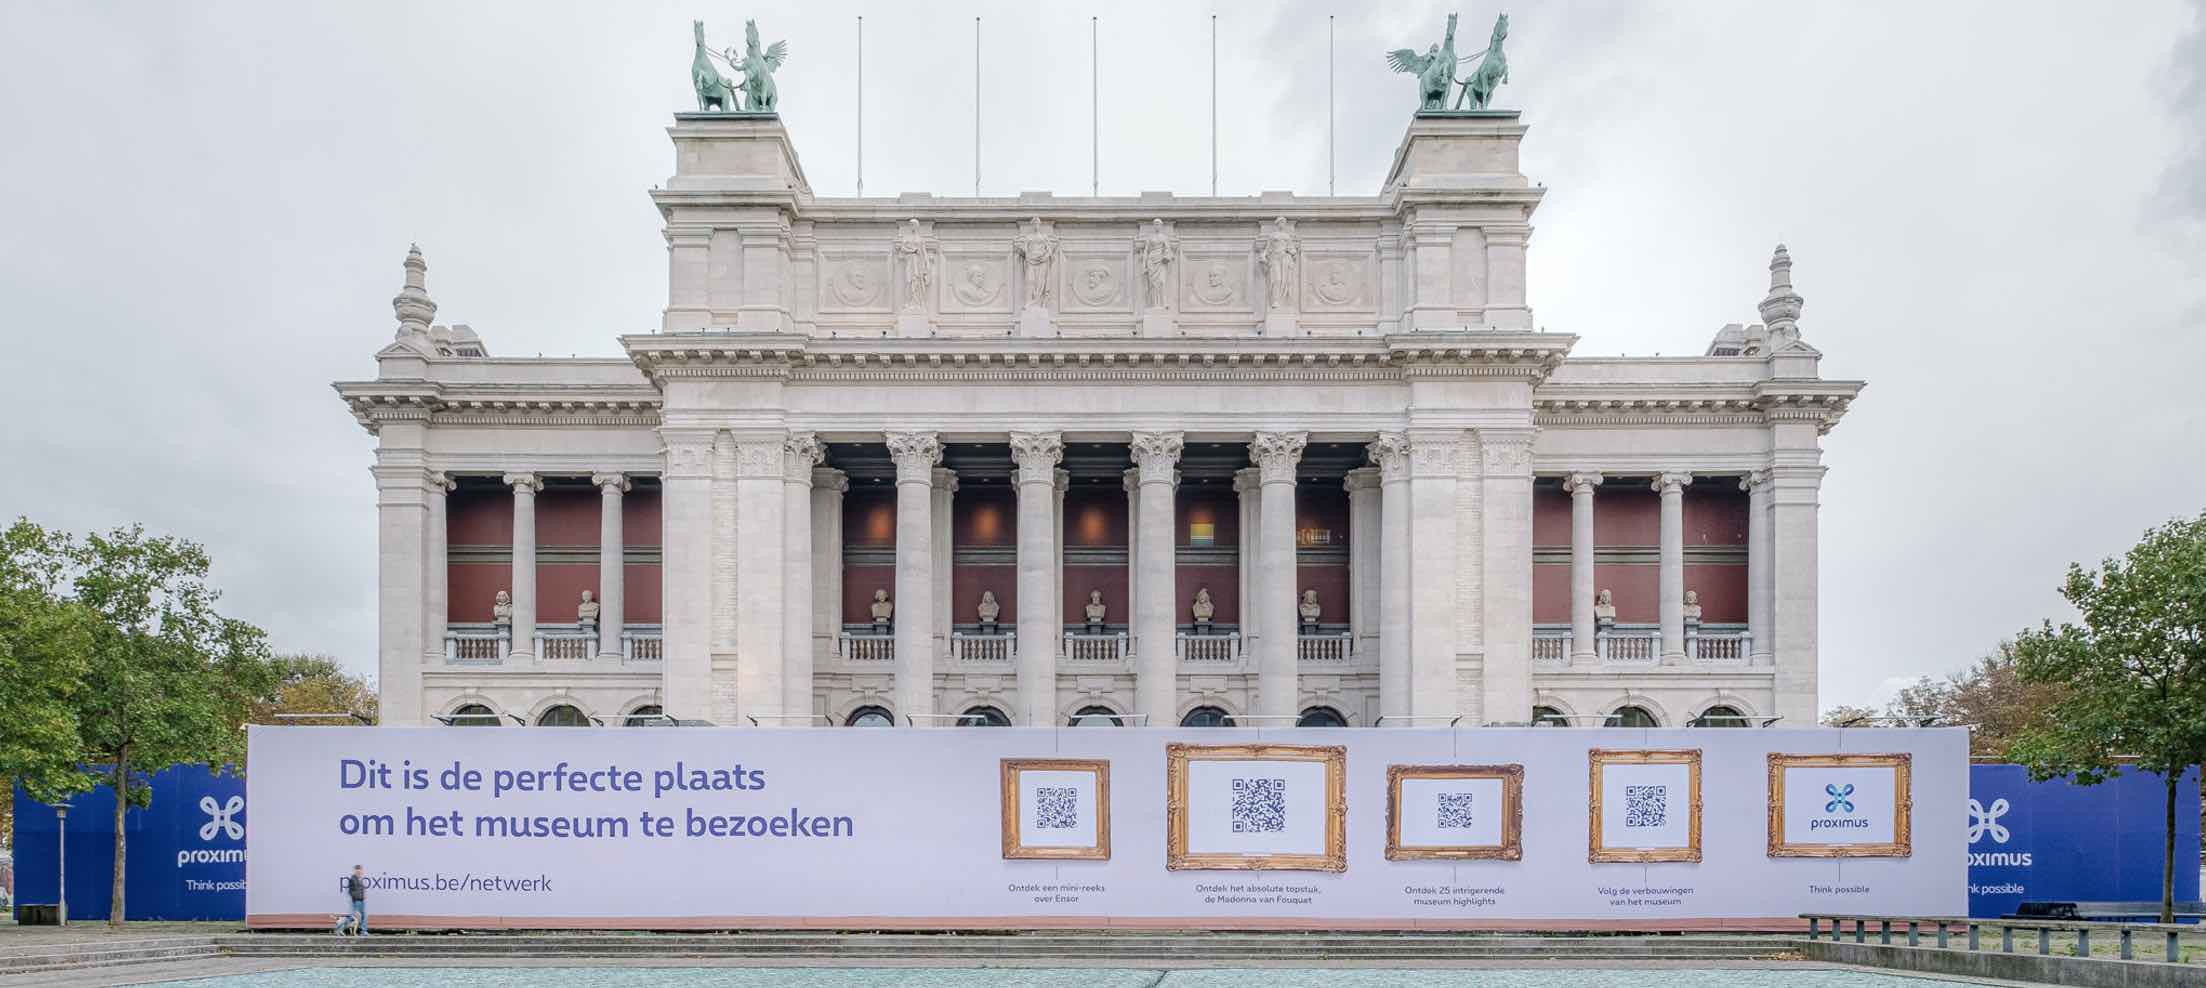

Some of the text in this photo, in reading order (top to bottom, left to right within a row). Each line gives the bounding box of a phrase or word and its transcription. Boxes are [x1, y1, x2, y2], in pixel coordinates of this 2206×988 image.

[340, 759, 766, 799] Dit is de perfecte plaats
[339, 806, 853, 839] om het museum te bezoeken
[1810, 818, 1869, 831] proximus
[185, 879, 215, 891] Think
[339, 871, 552, 893] poximus.be/netwerk
[1008, 883, 1040, 893] Ontdek
[1042, 885, 1058, 893] een
[1195, 883, 1228, 894] Ontdek
[1230, 884, 1244, 893] het
[1246, 883, 1284, 893] absolute
[1404, 885, 1437, 895] Ontdek
[1439, 886, 1450, 895] 25
[1598, 887, 1695, 897] Volg de verbouwingen
[1808, 885, 1871, 895] Think possible
[1981, 882, 2025, 896] possible
[1033, 894, 1079, 903] over Ensor
[1204, 894, 1313, 906] de Madonna van Fouquet
[1453, 897, 1496, 907] highlights
[1627, 898, 1643, 906] het
